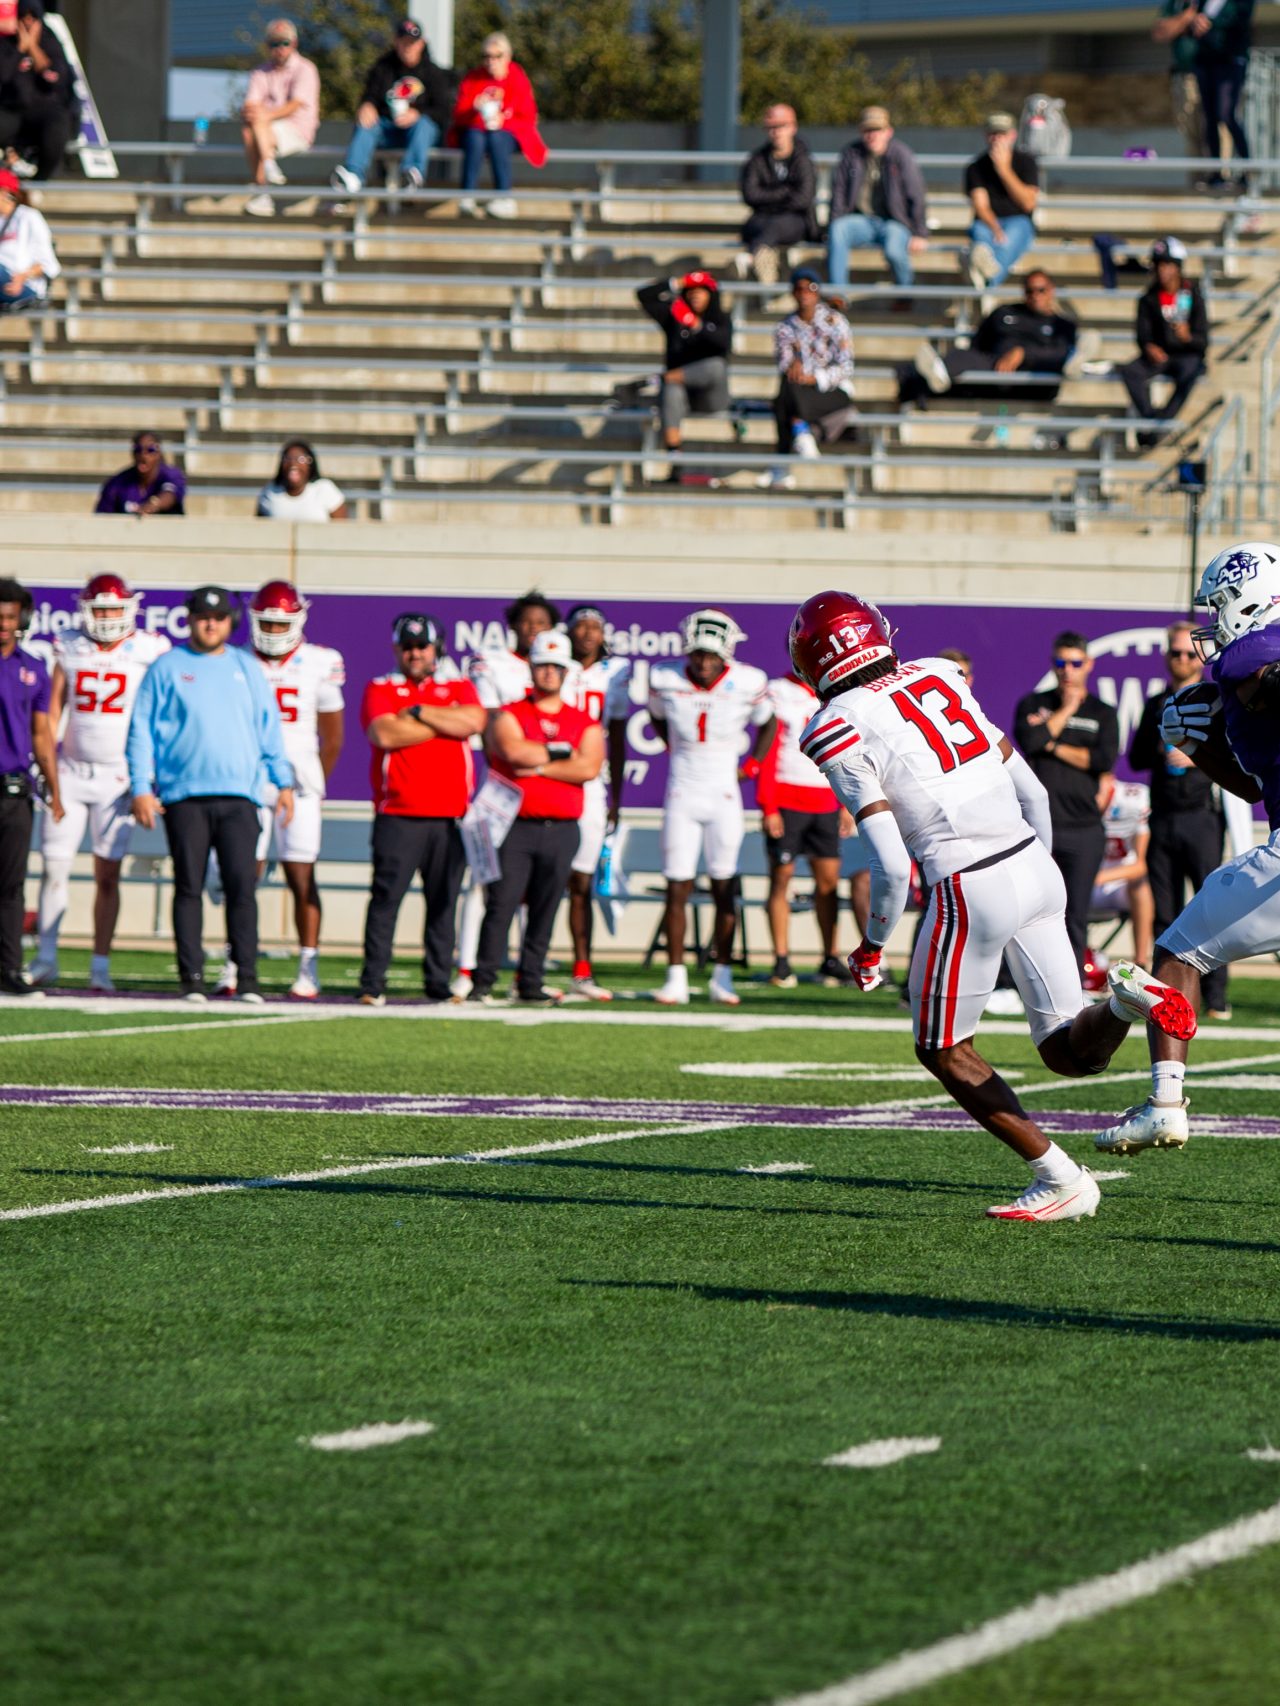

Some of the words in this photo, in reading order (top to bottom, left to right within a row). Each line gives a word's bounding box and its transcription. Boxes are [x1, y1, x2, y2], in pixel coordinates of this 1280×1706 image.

[145, 606, 192, 639] FC
[828, 625, 860, 655] 13
[827, 648, 881, 682] CARDINALS
[75, 671, 127, 714] 52
[275, 687, 299, 722] 5
[889, 674, 990, 774] 13
